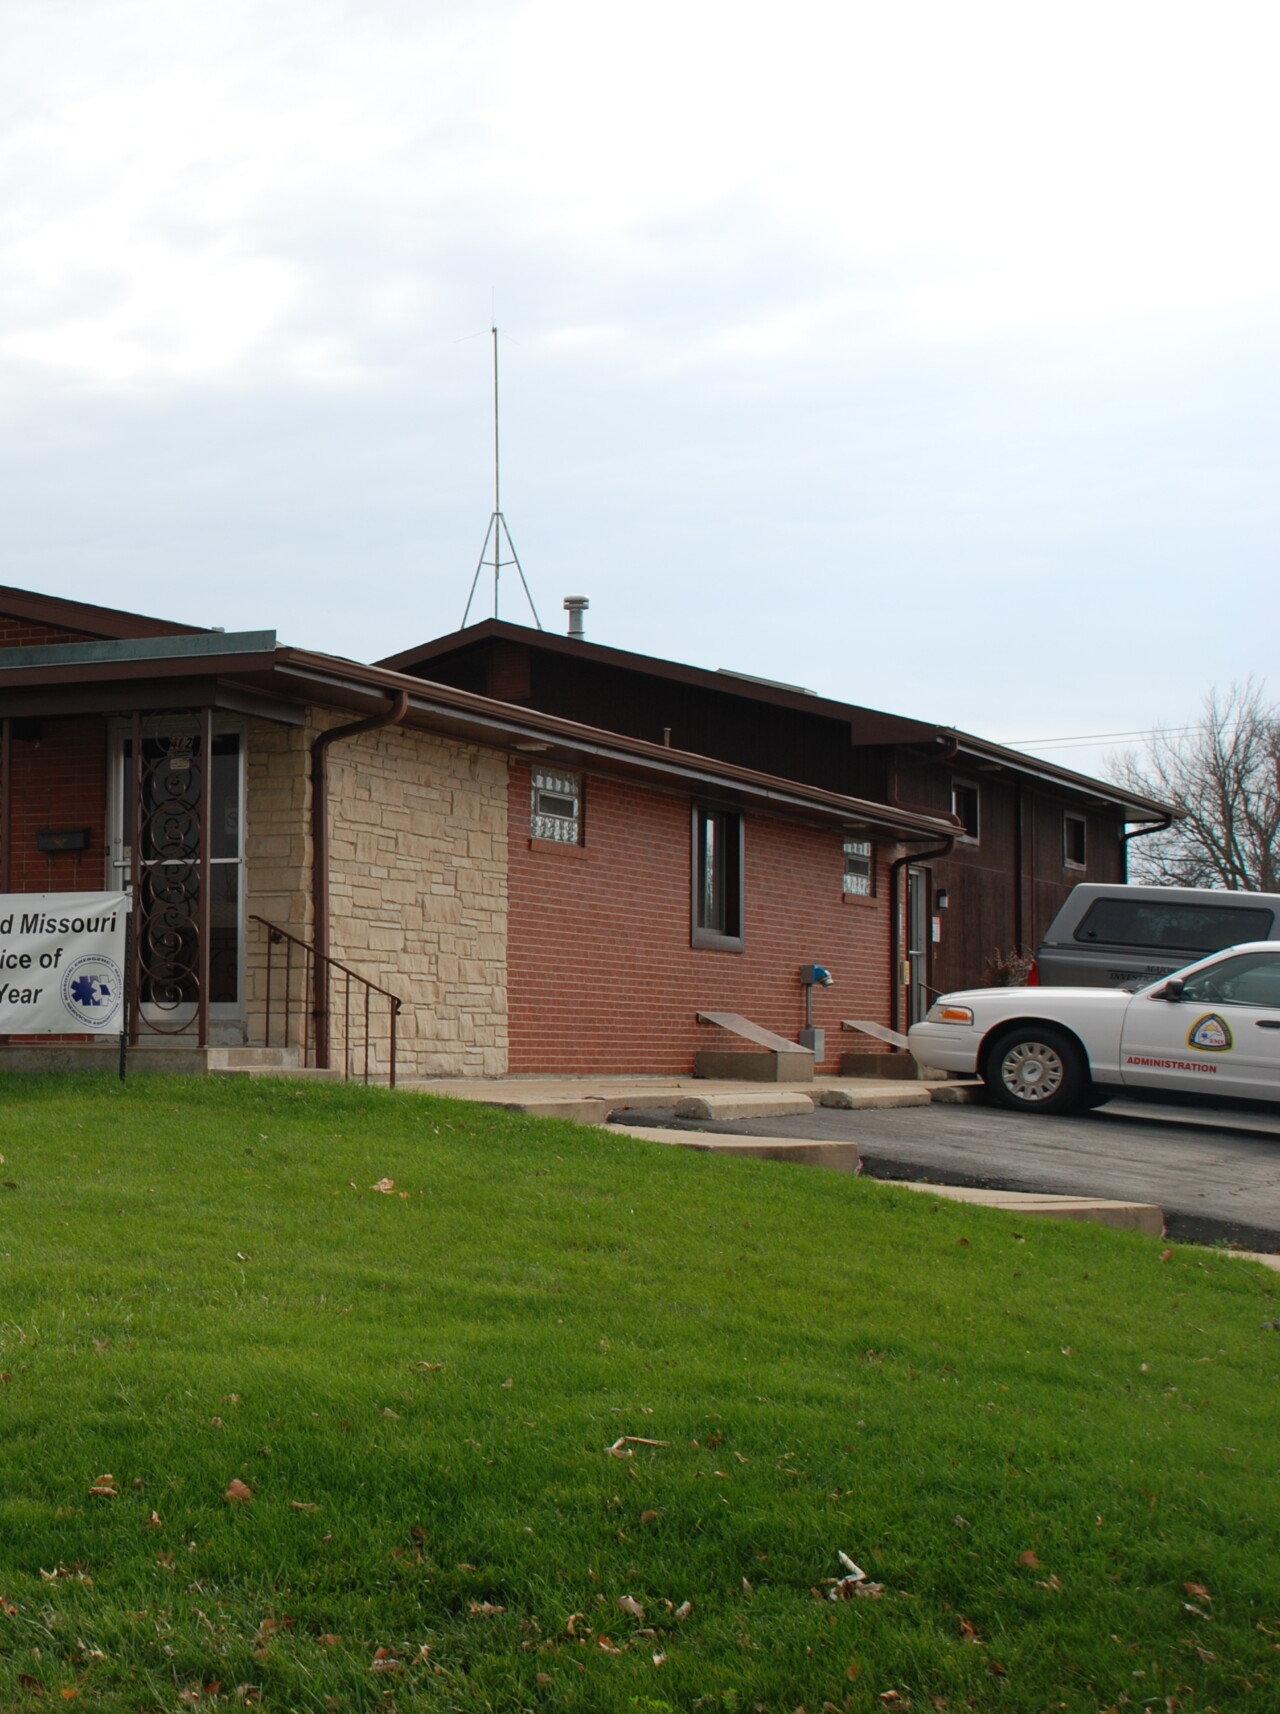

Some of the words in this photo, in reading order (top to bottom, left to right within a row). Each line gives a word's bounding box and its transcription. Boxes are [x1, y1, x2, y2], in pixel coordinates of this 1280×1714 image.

[20, 912, 117, 934] Missouri
[39, 948, 63, 969] of
[1127, 1056, 1218, 1073] ADMINISTRATION
